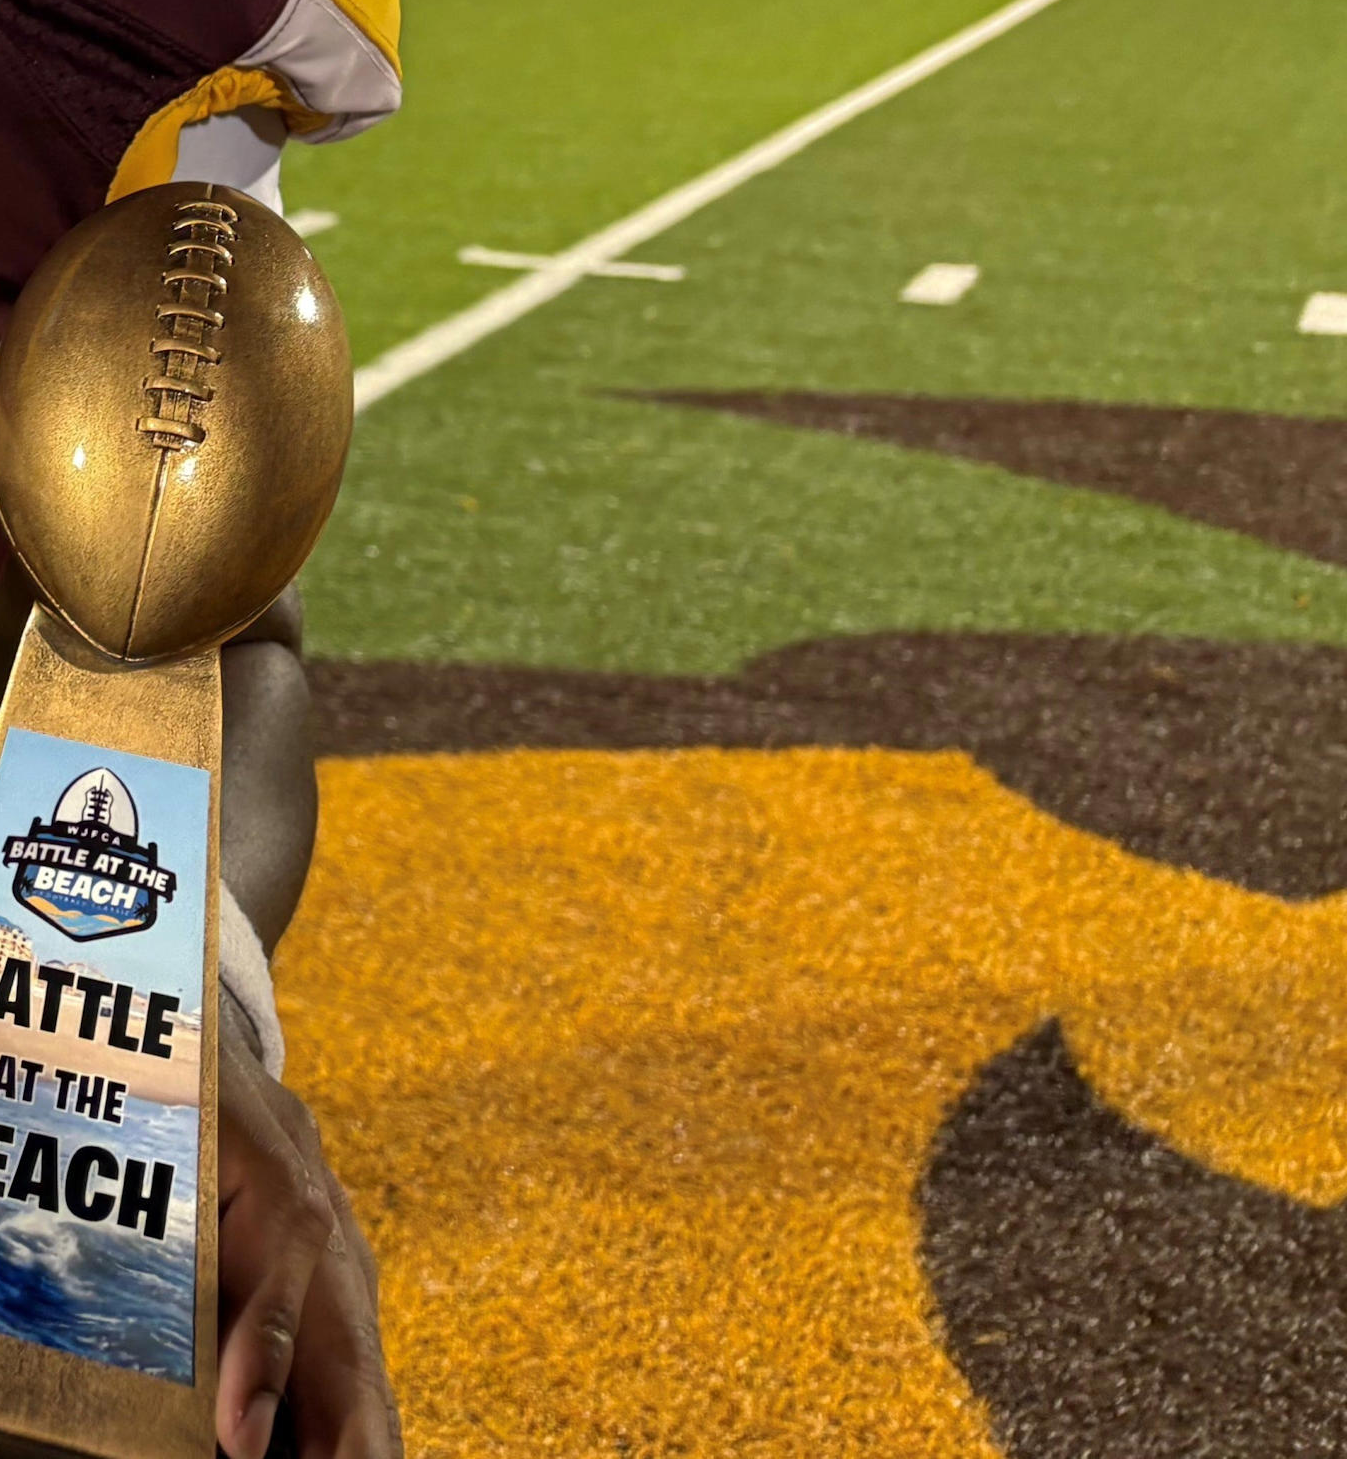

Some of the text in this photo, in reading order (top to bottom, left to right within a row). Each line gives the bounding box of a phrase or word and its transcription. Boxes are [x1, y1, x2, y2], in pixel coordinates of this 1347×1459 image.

[67, 825, 121, 846] WJFCA
[9, 841, 169, 892] BATTLE AT THE
[33, 867, 138, 909] BEACH
[55, 1068, 128, 1127] THE
